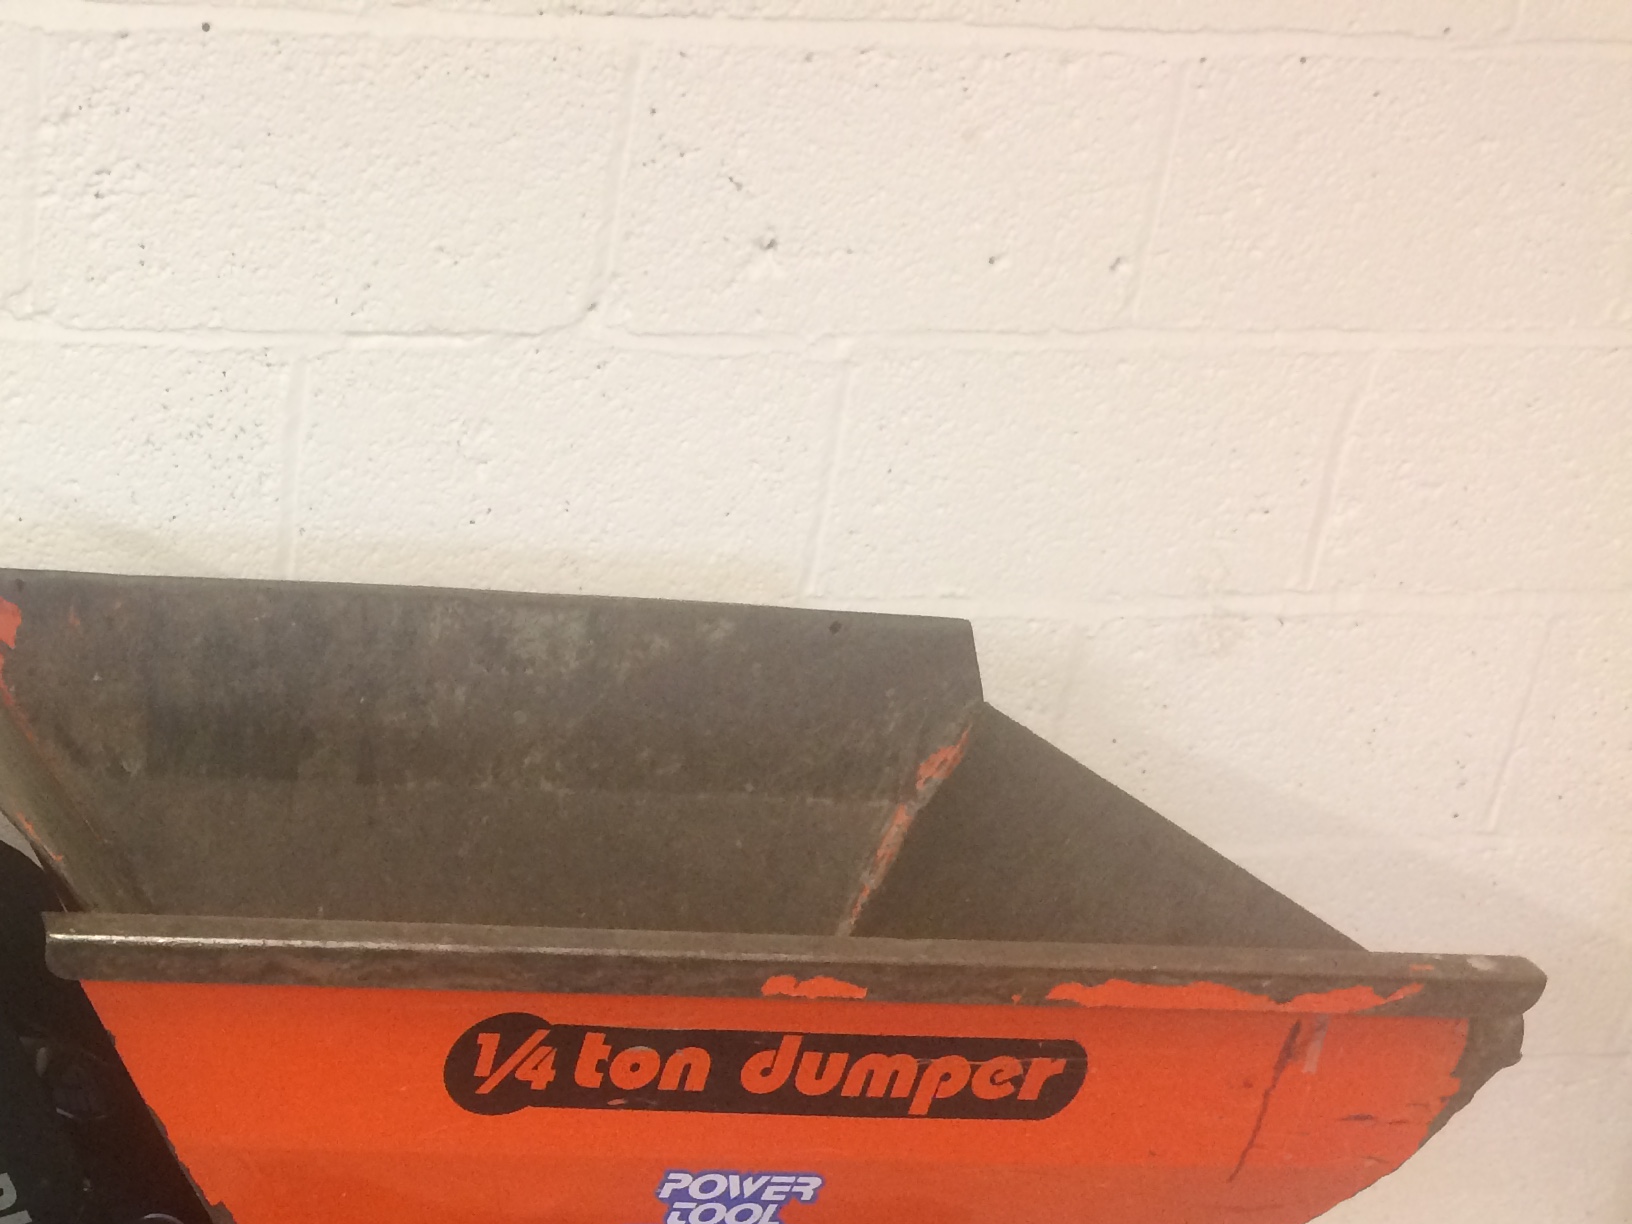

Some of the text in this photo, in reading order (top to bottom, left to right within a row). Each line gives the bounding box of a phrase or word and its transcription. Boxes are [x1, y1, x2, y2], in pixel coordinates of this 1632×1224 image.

[574, 1032, 711, 1092] ton
[740, 1035, 1066, 1115] dumper
[658, 1173, 824, 1201] POWER
